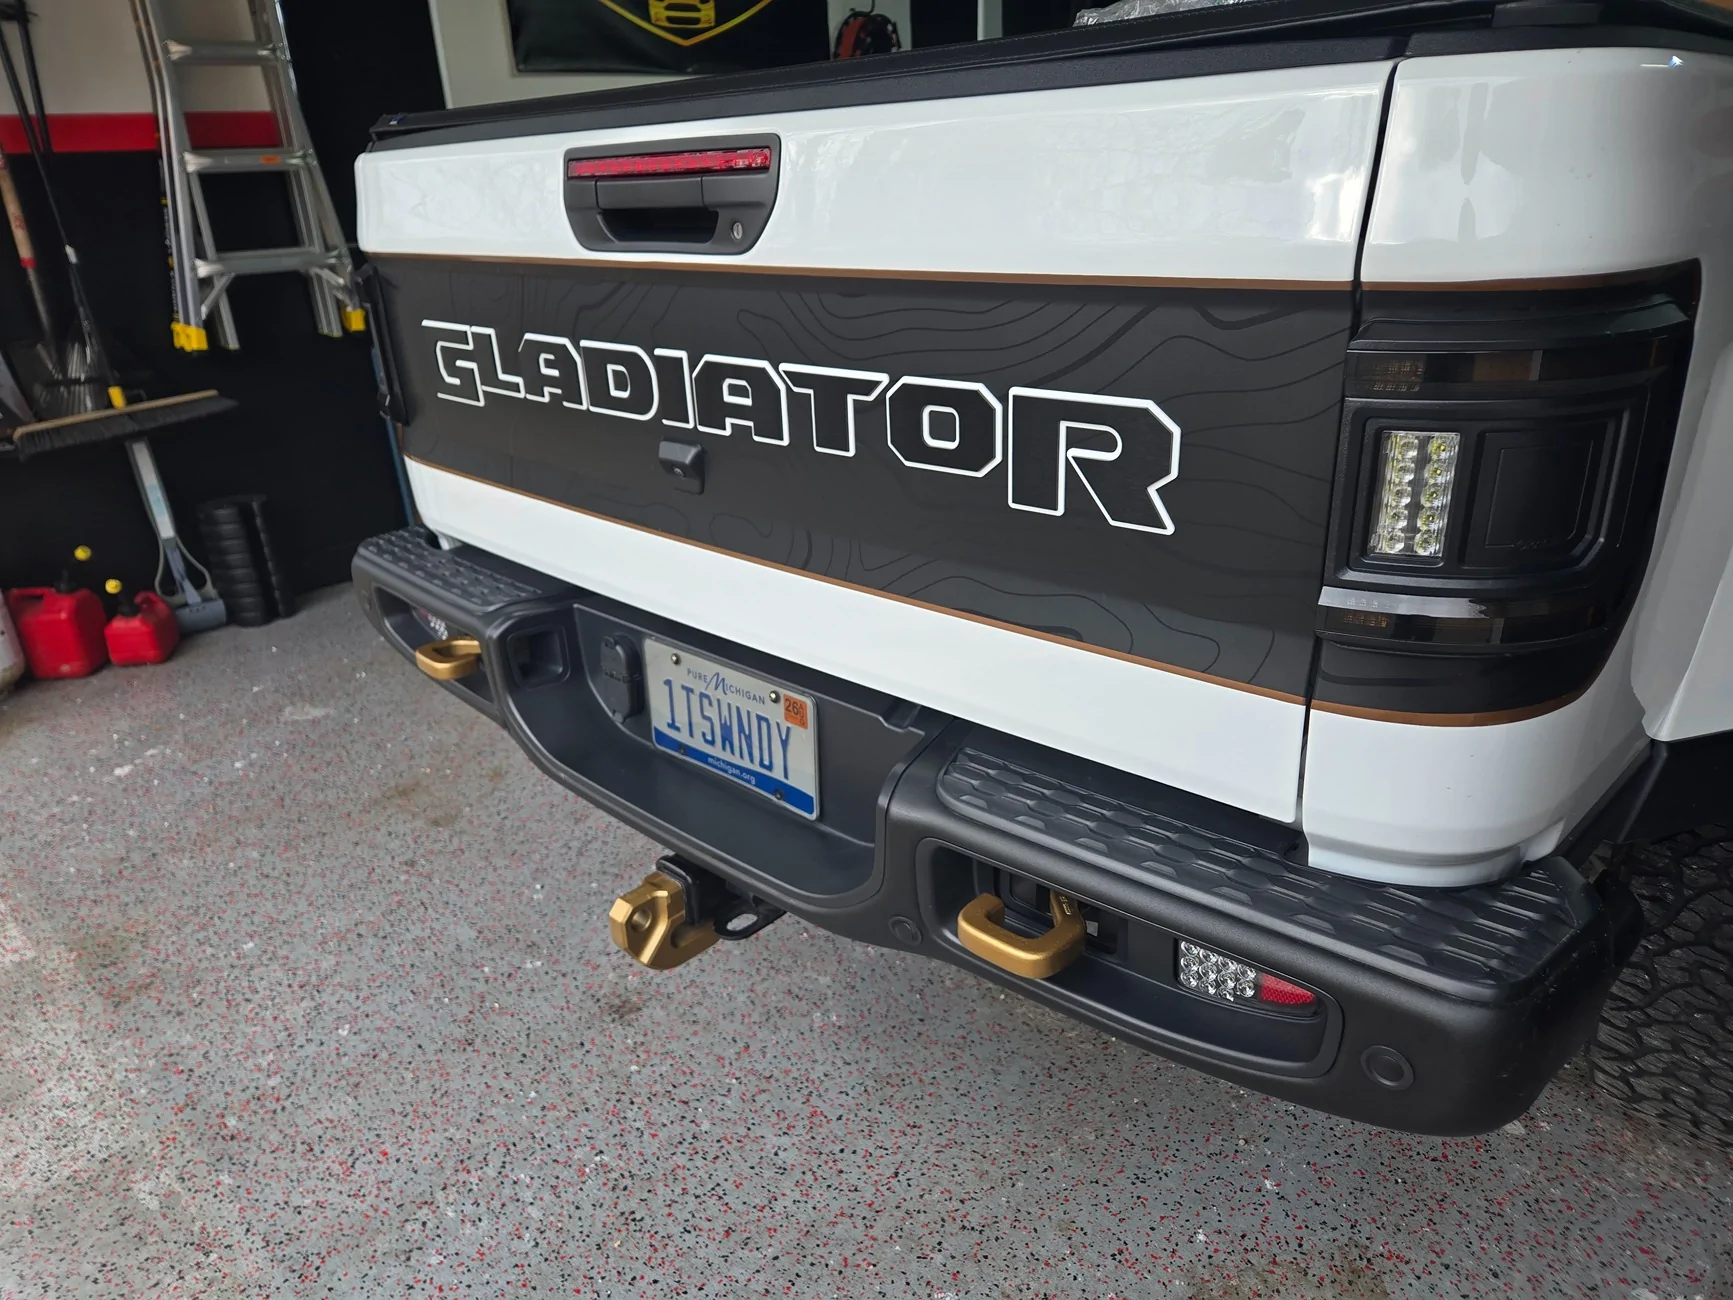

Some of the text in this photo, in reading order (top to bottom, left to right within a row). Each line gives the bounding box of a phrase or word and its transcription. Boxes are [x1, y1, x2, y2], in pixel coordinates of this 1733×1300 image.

[421, 319, 1182, 535] GLADIATOR
[687, 668, 708, 683] PURE
[785, 698, 799, 715] 26
[663, 678, 791, 781] 1TSWNDY
[708, 757, 756, 785] michigan.org
